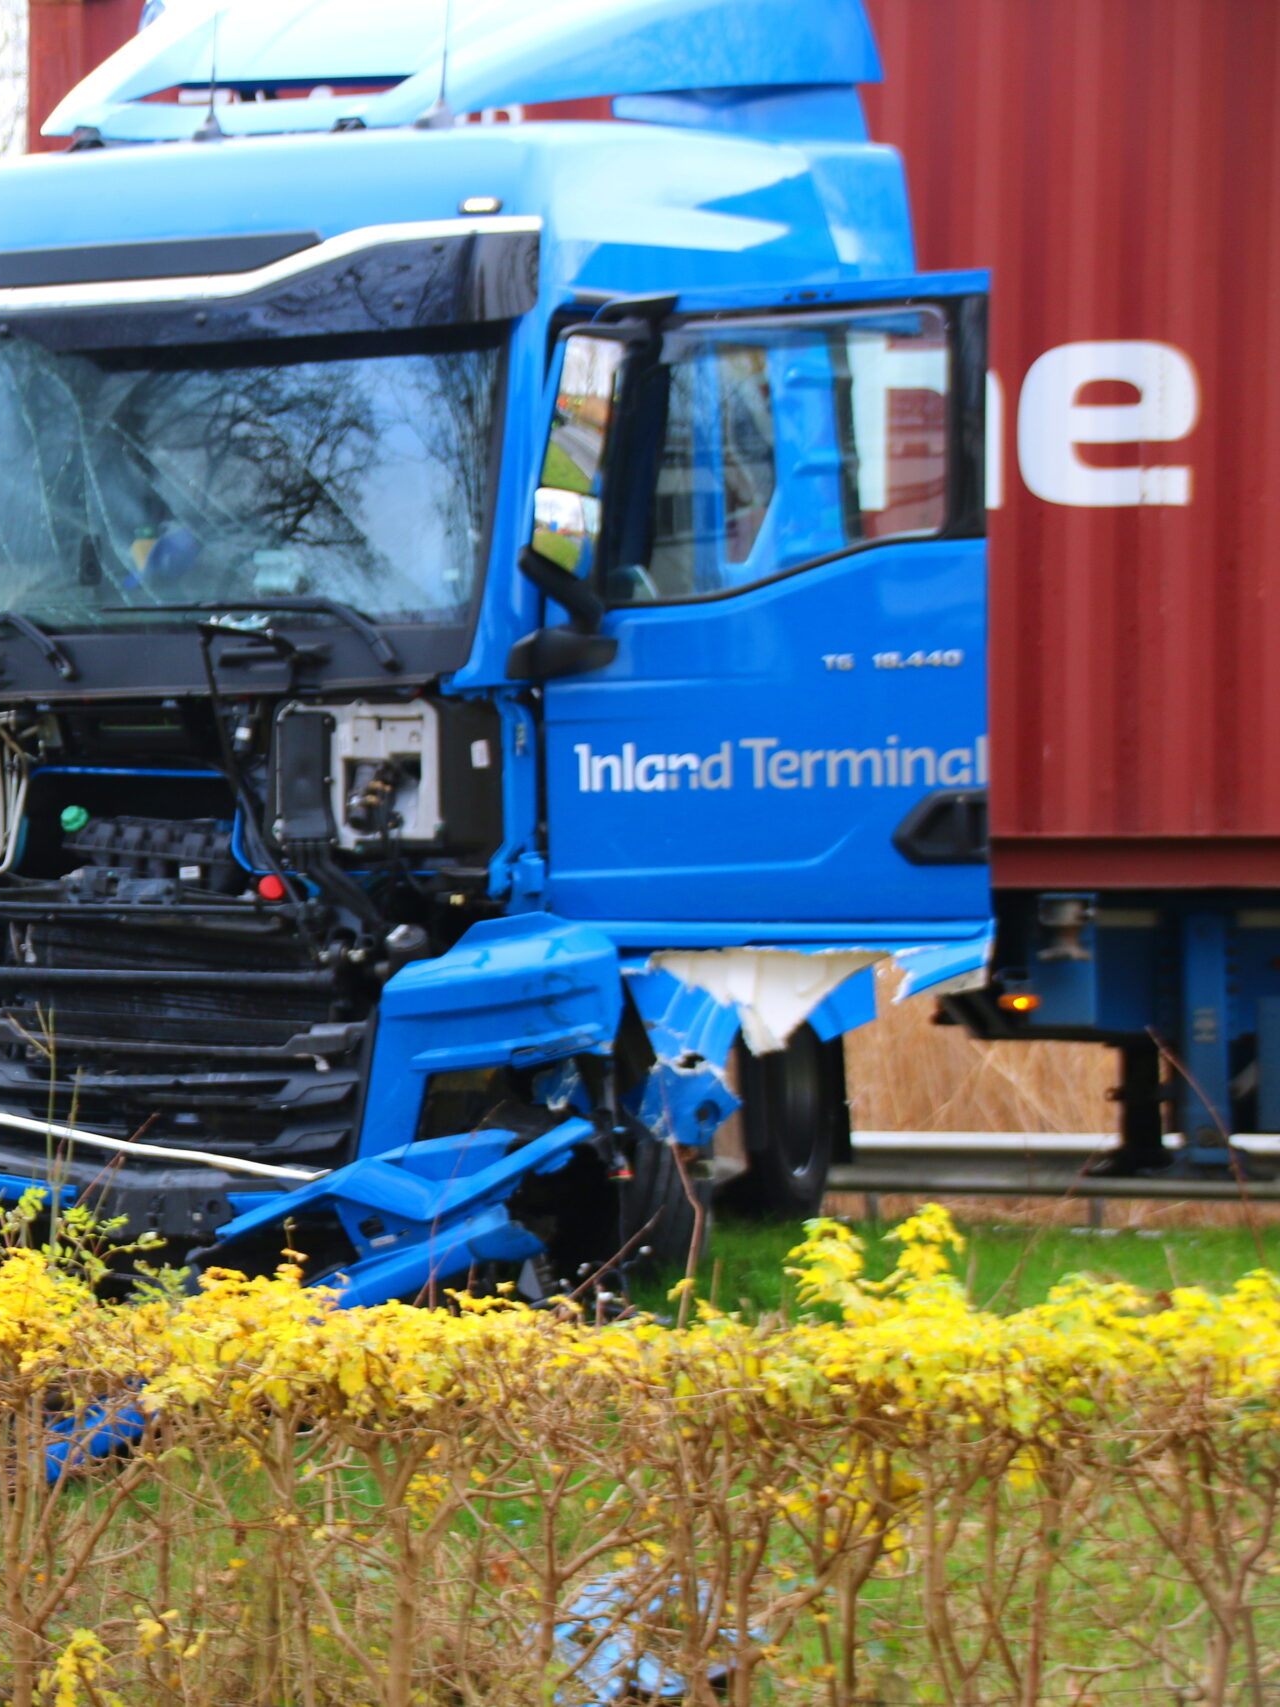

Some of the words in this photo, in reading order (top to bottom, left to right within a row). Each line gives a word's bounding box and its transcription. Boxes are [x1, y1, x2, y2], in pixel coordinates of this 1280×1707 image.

[872, 649, 964, 669] 18.440
[574, 741, 732, 793] Inland
[738, 733, 988, 789] Terminal
